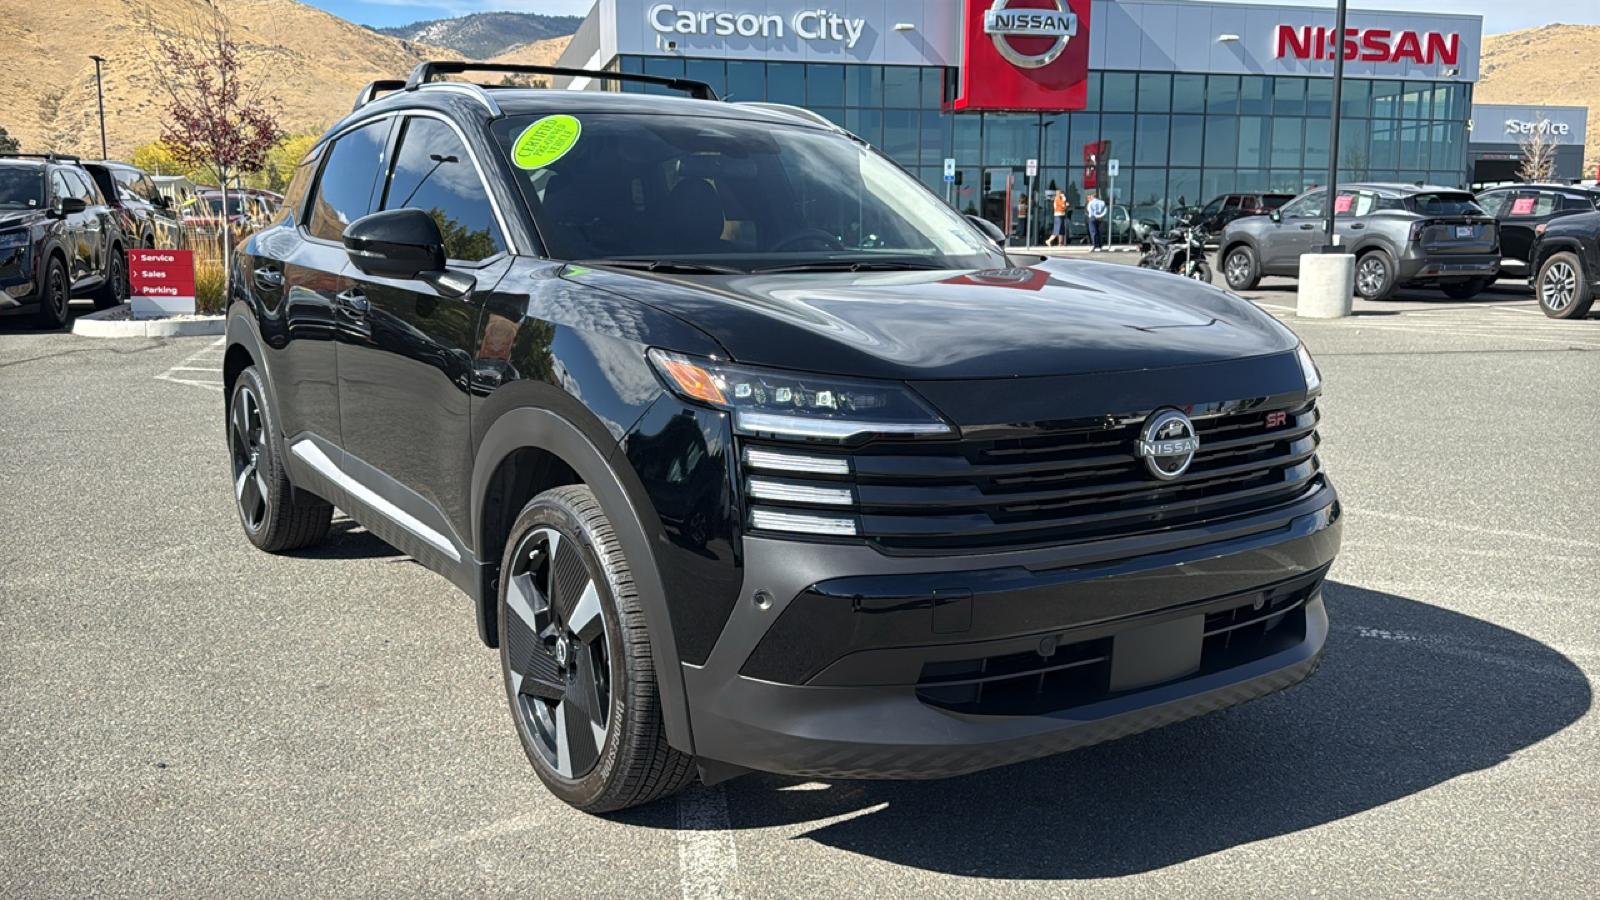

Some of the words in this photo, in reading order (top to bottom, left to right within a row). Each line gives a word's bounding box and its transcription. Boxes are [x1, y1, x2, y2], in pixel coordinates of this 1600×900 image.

[649, 4, 783, 38] Carson
[793, 10, 865, 48] City
[995, 14, 1070, 31] NISSAN
[1276, 25, 1460, 65] NISSAN
[1507, 119, 1569, 135] Service
[518, 120, 557, 157] CERTIFIED
[140, 254, 175, 262] Service
[141, 270, 167, 278] Sales
[142, 285, 178, 296] Parking
[1265, 411, 1286, 427] SR
[1144, 439, 1199, 455] NISSAN
